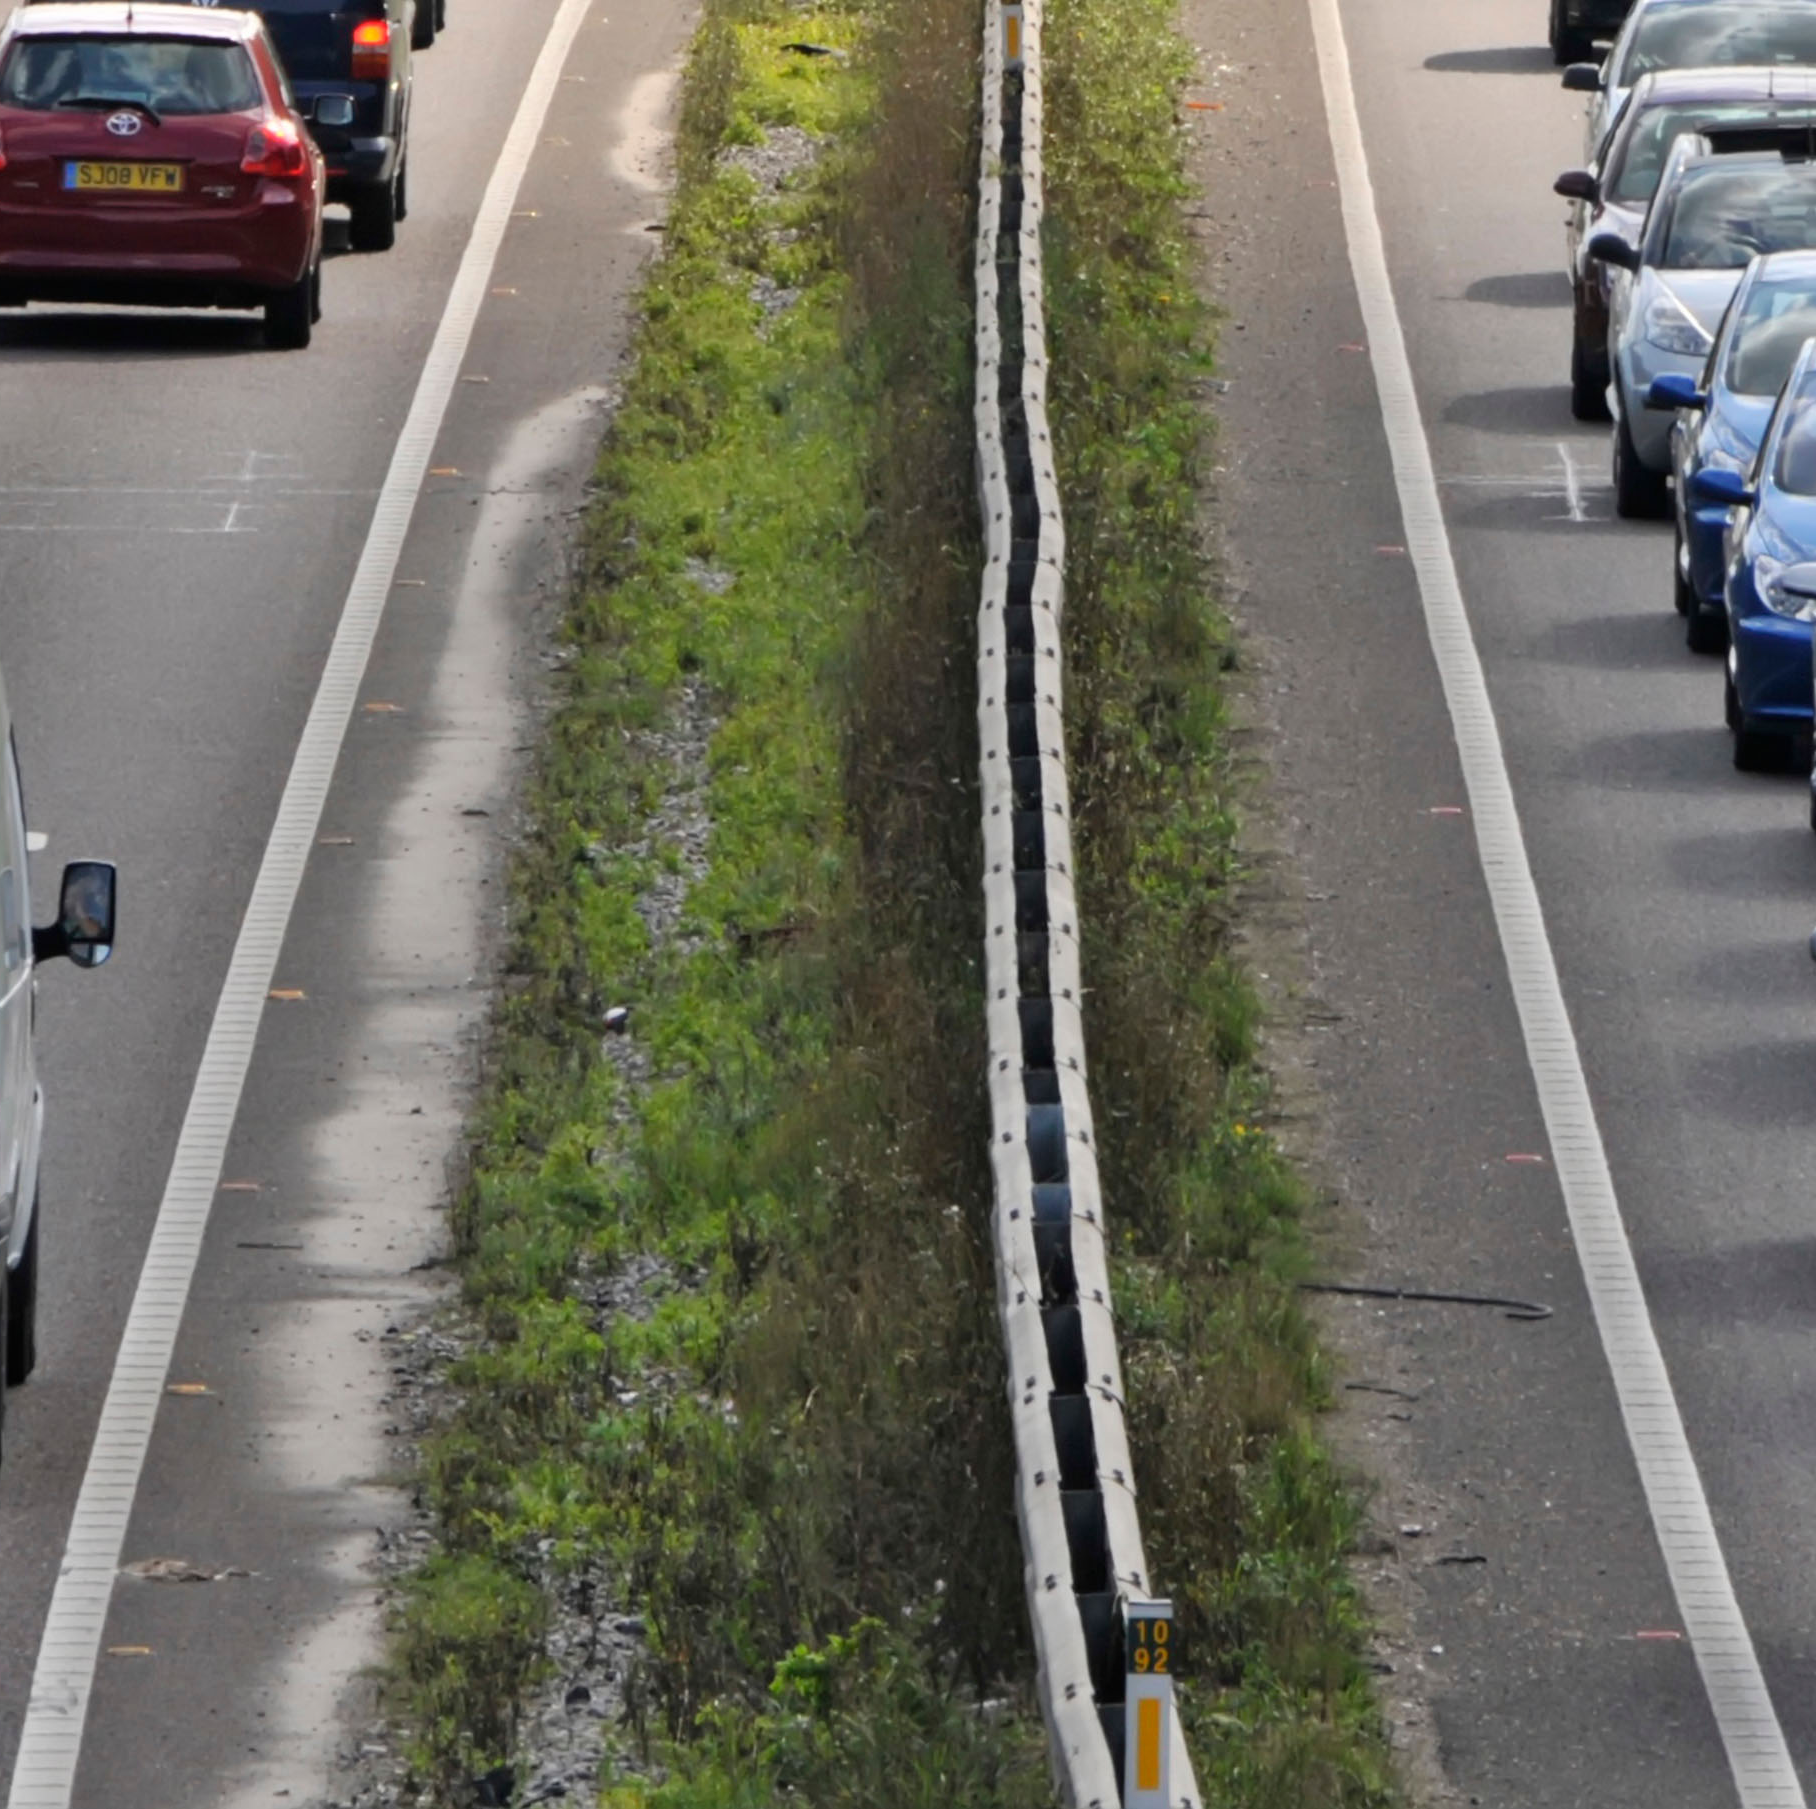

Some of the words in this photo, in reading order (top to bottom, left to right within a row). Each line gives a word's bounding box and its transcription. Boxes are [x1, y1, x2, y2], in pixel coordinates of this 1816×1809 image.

[80, 164, 132, 185] SJ08
[137, 167, 177, 186] VFW
[1136, 1619, 1170, 1645] 10
[1133, 1647, 1170, 1674] 92
